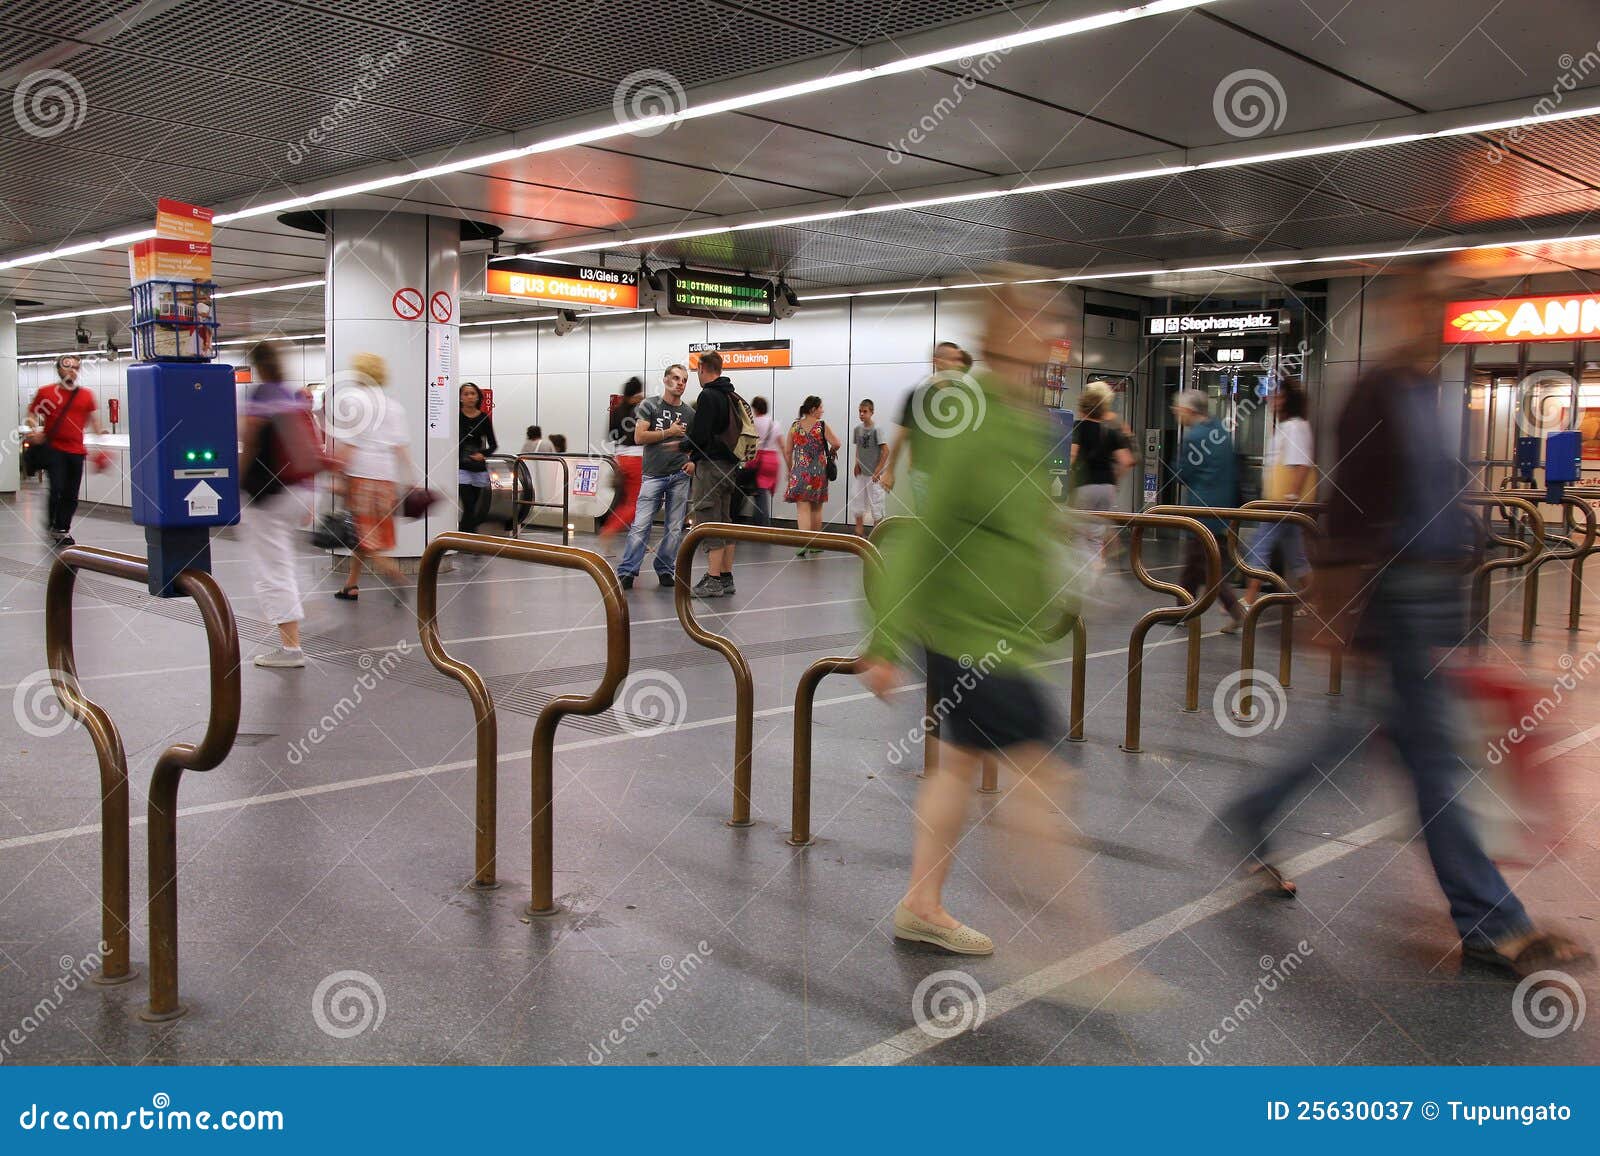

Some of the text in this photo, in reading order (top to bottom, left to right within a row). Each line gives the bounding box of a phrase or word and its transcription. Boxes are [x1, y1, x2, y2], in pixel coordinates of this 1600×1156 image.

[580, 268, 628, 284] U3/Gleis 2
[526, 278, 608, 302] U3 Ottakring
[676, 280, 686, 288] U3
[690, 282, 732, 294] OTTAKRING
[676, 294, 686, 302] U3
[690, 295, 732, 307] OTTAKRING
[1180, 313, 1272, 333] Stephansplatz
[733, 353, 769, 364] Ottakring
